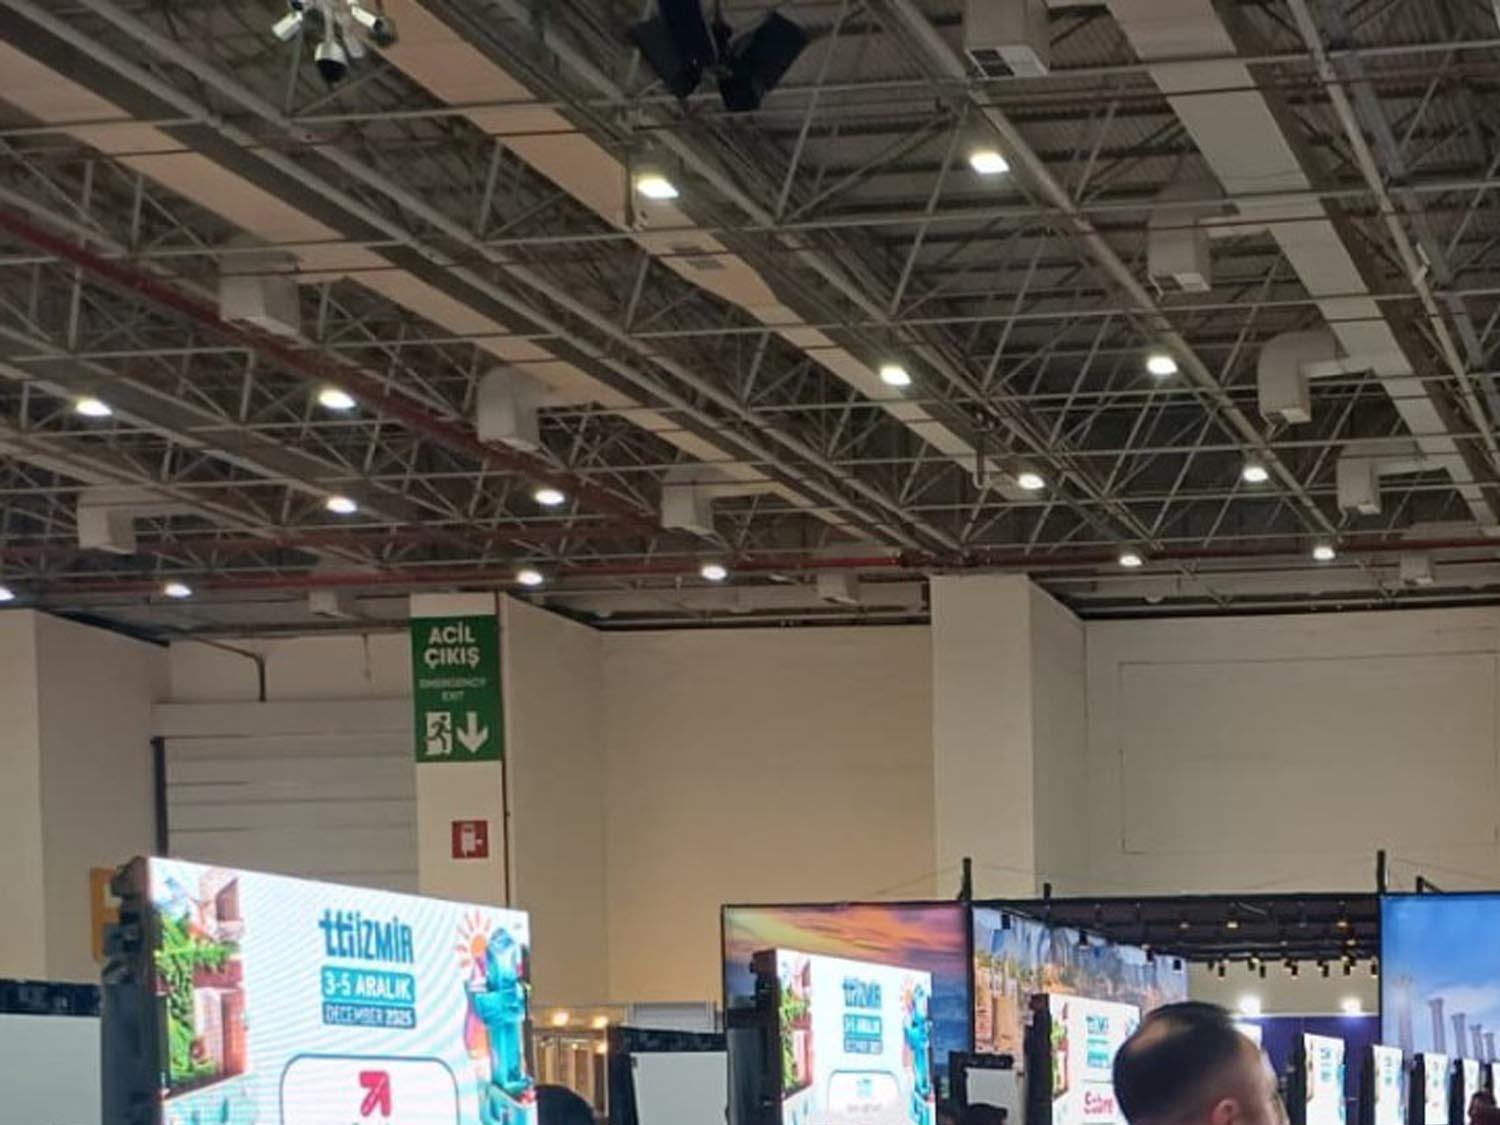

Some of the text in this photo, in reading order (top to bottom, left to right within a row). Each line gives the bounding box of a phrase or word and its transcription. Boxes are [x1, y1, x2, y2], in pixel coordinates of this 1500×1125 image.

[428, 621, 476, 645] ACİL
[424, 647, 480, 669] ÇIKIŞ
[323, 970, 413, 1001] 3-5 ARALIK
